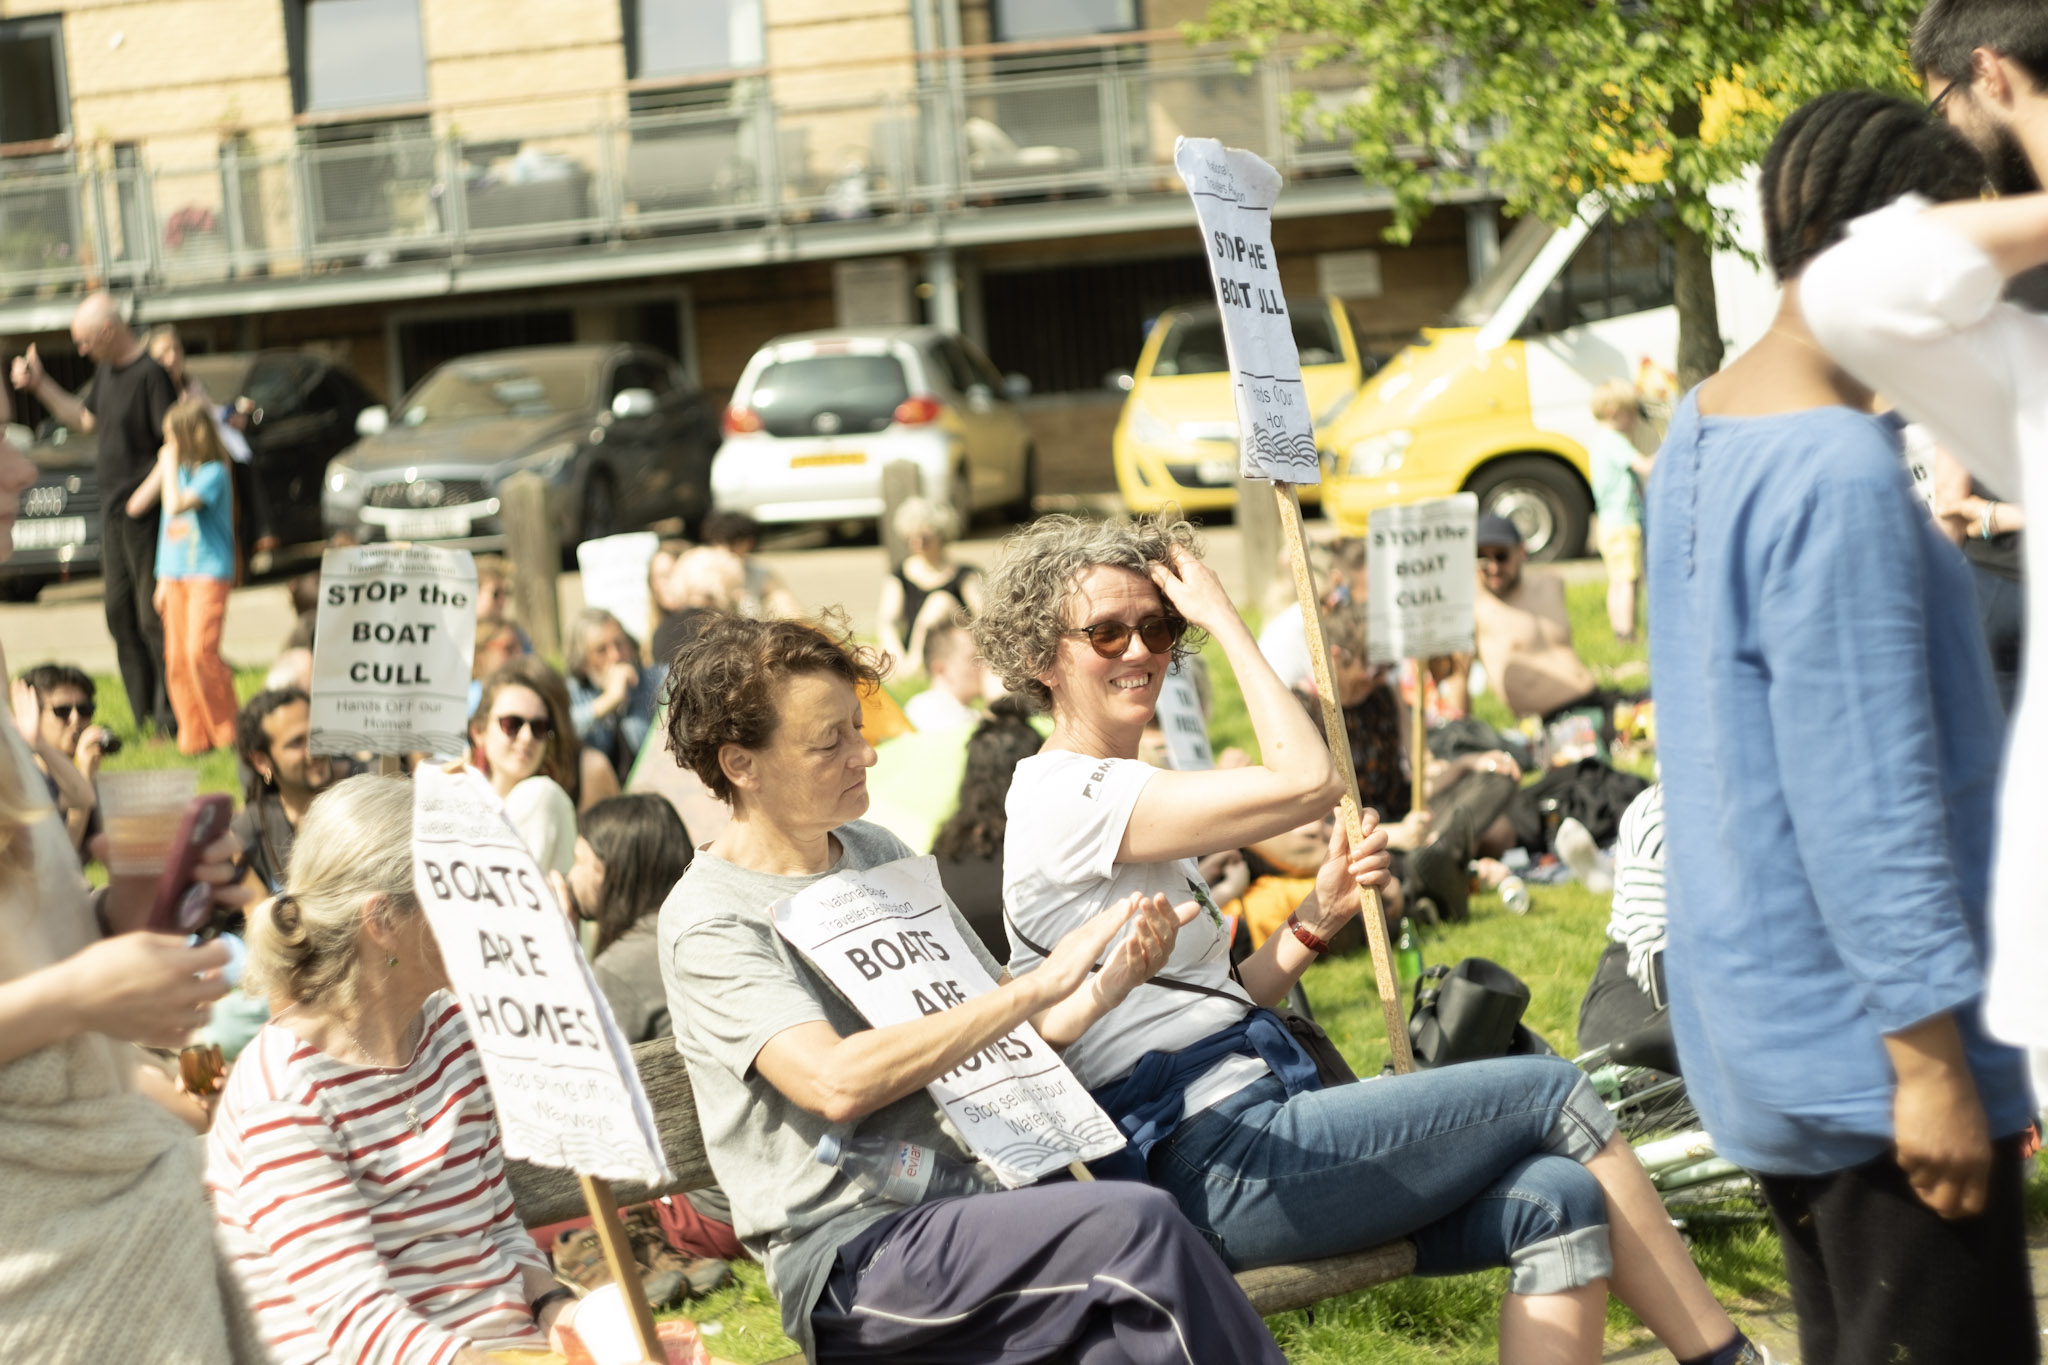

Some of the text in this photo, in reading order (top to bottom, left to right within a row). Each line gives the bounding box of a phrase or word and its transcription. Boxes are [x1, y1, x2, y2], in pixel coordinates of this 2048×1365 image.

[1246, 243, 1268, 270] HE
[1258, 288, 1285, 314] ULL
[1373, 528, 1430, 547] STOP
[1396, 556, 1447, 576] BOAT
[327, 581, 468, 608] STOP the
[1396, 586, 1444, 607] CULL
[352, 622, 437, 644] BOAT
[350, 662, 431, 684] CULL
[336, 699, 381, 713] Hands
[423, 860, 541, 911] BOATS
[820, 884, 868, 910] National
[819, 902, 877, 933] Travellers
[478, 928, 548, 977] ARE
[844, 930, 951, 981] BOATS
[911, 980, 967, 1016] ARE
[469, 993, 600, 1051] HOMES
[963, 1101, 1001, 1124] Stop
